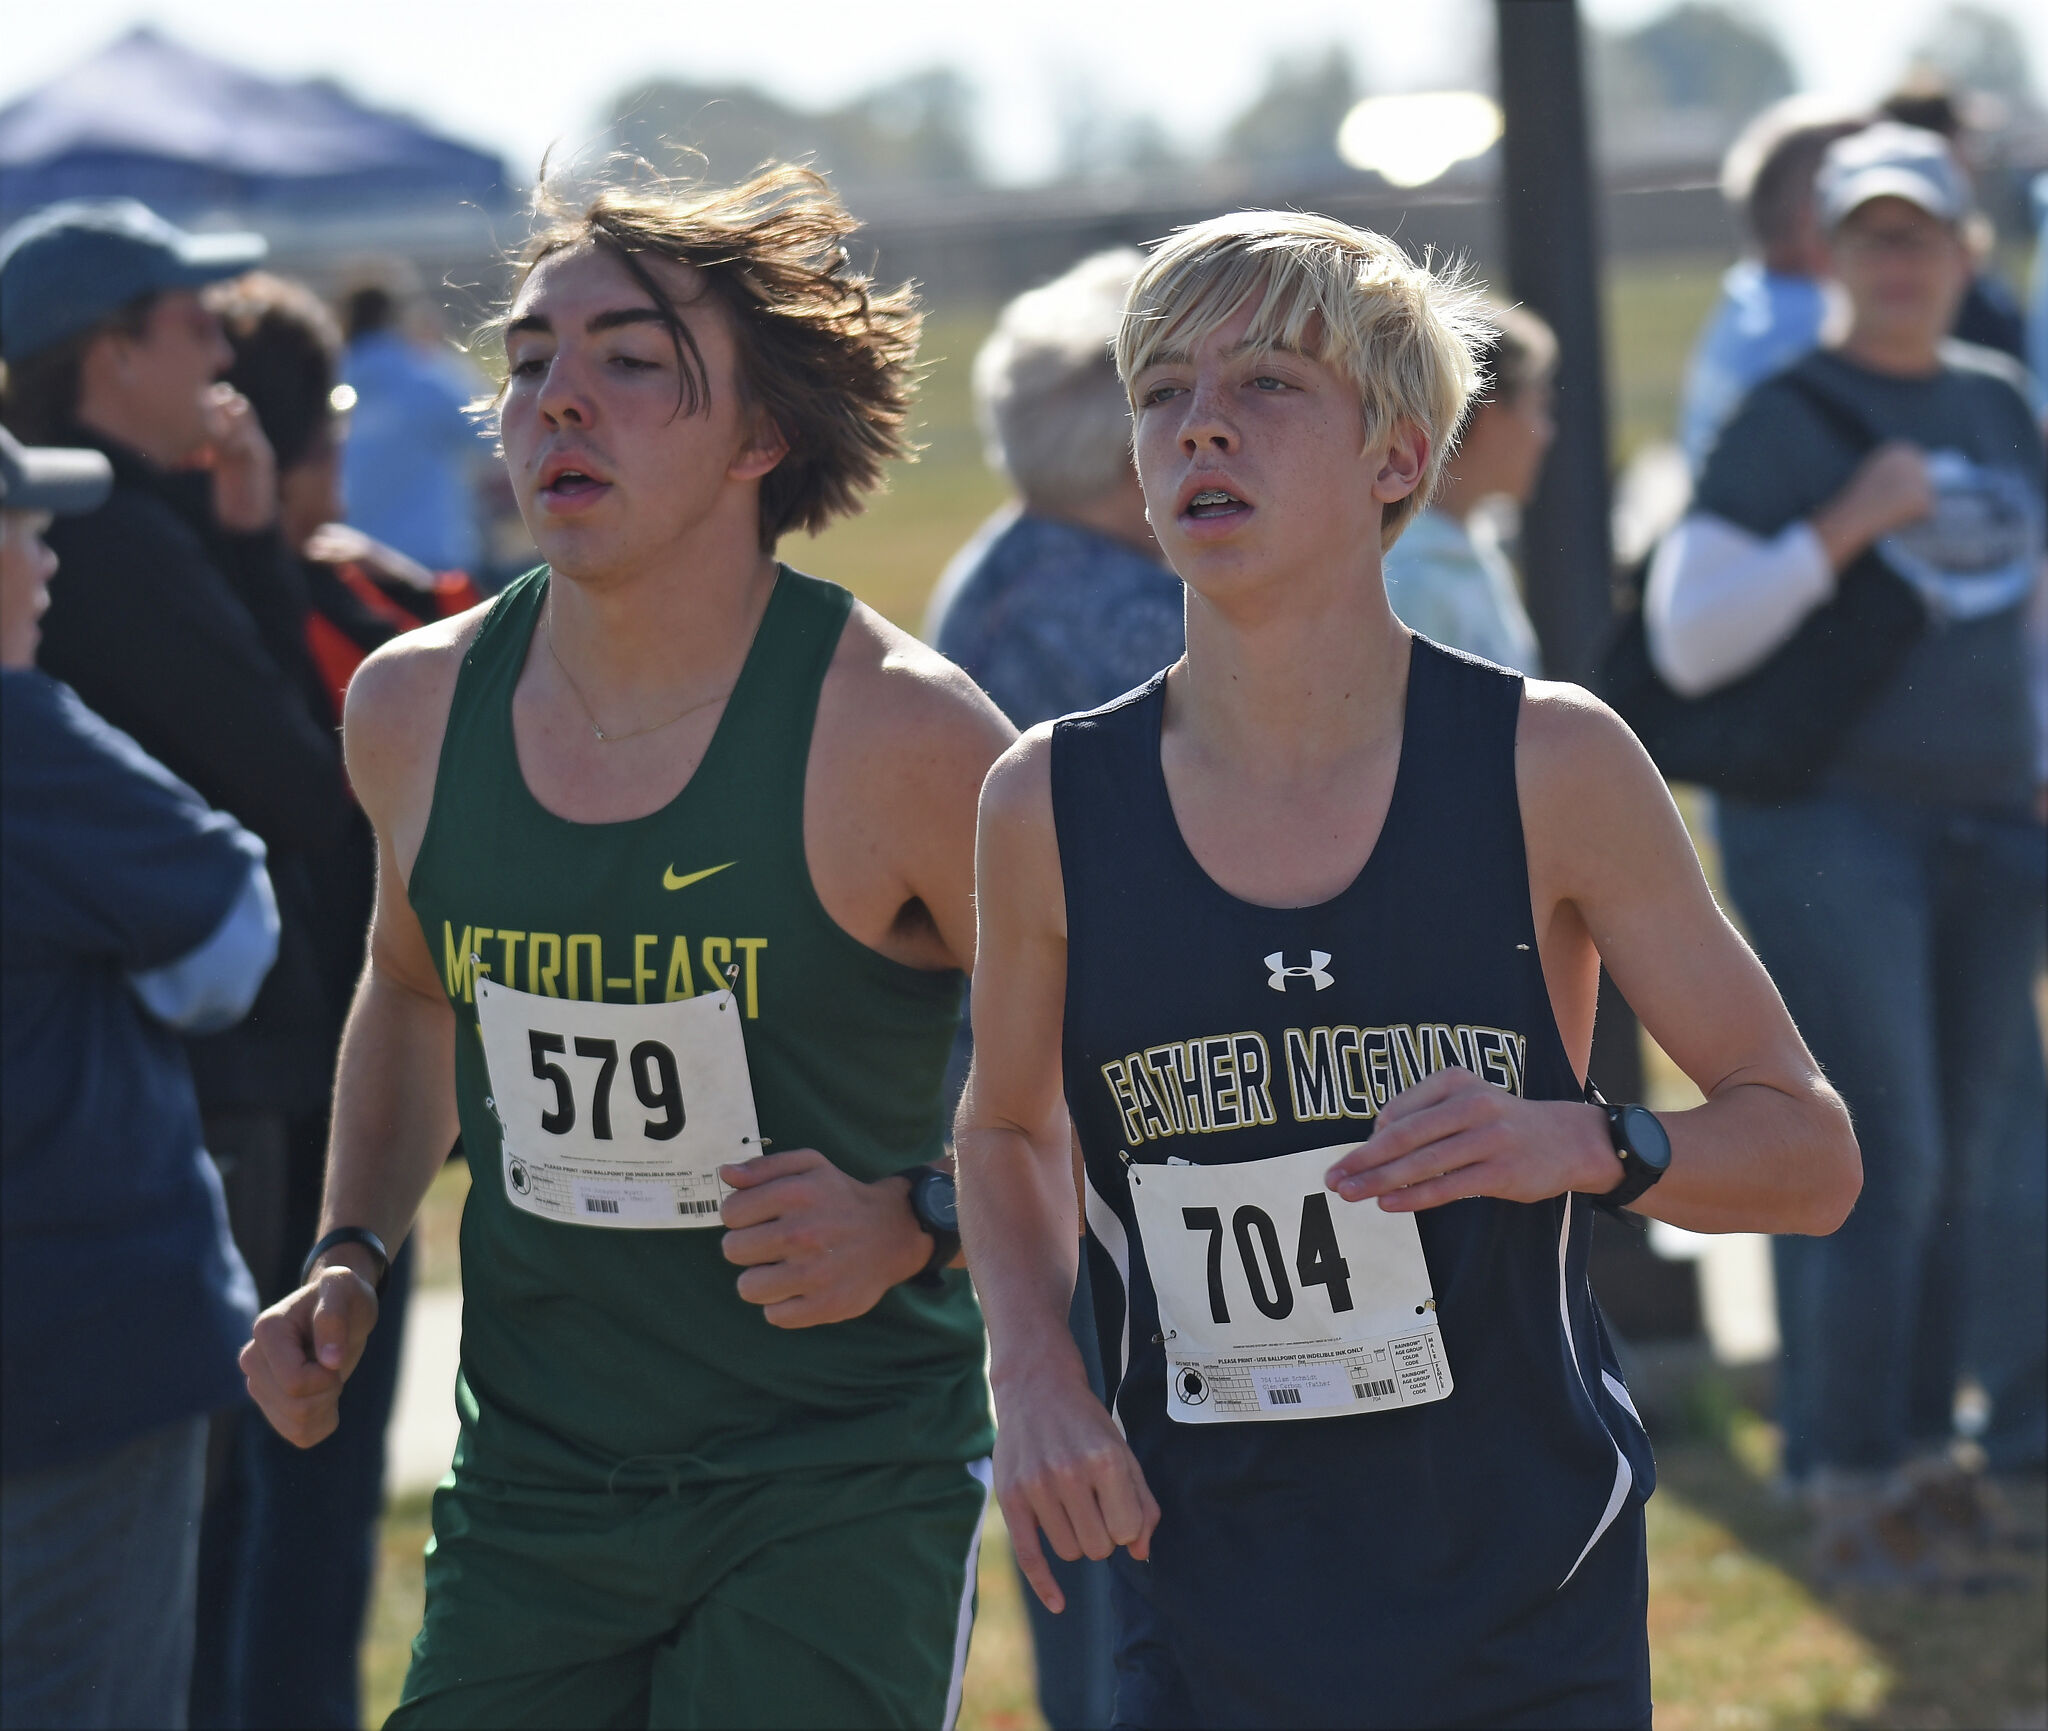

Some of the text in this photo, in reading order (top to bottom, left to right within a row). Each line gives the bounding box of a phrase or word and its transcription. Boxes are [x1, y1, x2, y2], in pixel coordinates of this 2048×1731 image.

[444, 919, 768, 1019] METRO-EAST
[528, 1028, 686, 1141] 579
[1101, 1030, 1278, 1147] FATHER
[1181, 1191, 1354, 1324] 704
[1218, 1357, 1237, 1365] PLEASE
[1267, 1354, 1297, 1362] BALLPOINT
[1306, 1351, 1335, 1360] INDELIBLE
[1347, 1346, 1364, 1354] ONLY
[1402, 1353, 1419, 1361] COLOR
[1406, 1346, 1423, 1354] GROUP
[1428, 1337, 1437, 1359] MALE
[1409, 1382, 1427, 1390] COLOR
[1413, 1375, 1431, 1383] GROUP
[1412, 1388, 1427, 1396] CODE
